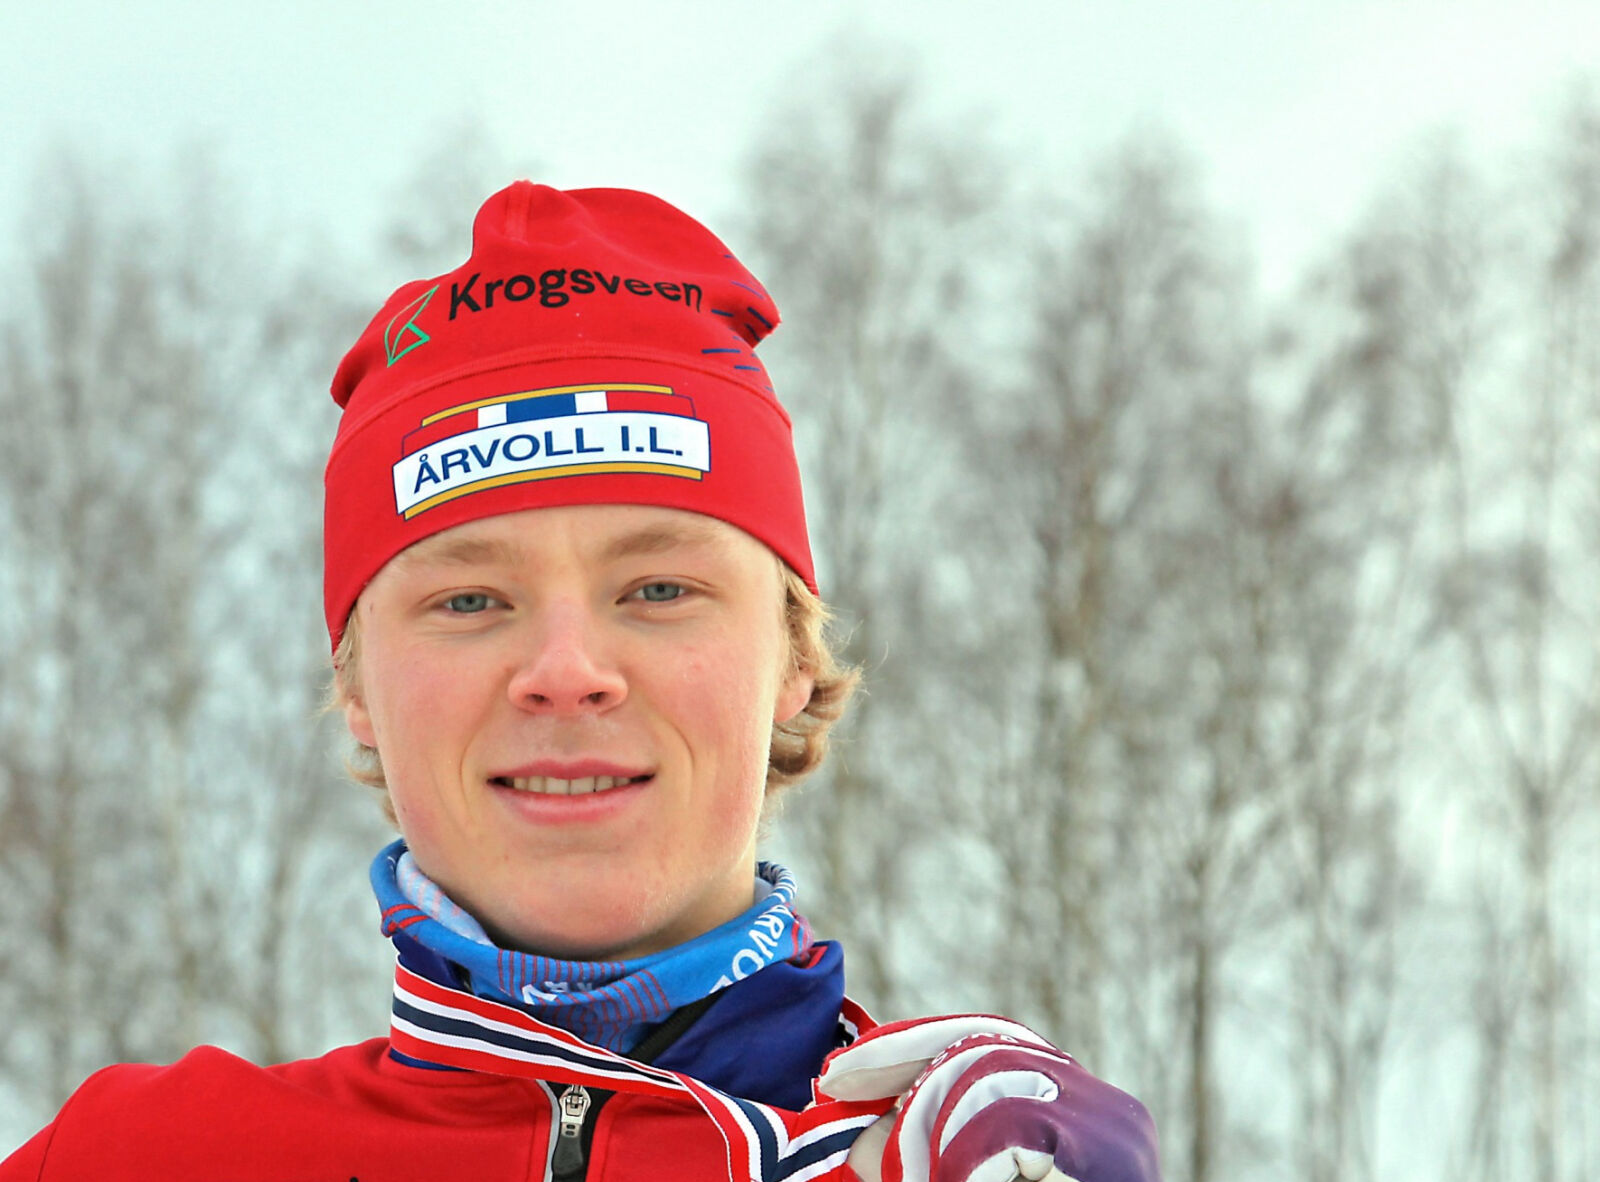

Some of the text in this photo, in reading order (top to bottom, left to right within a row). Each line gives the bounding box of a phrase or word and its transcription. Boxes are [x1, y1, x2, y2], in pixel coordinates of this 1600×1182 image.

[448, 268, 703, 321] Krogsveen
[412, 425, 684, 494] ÅRVOLL I.L.
